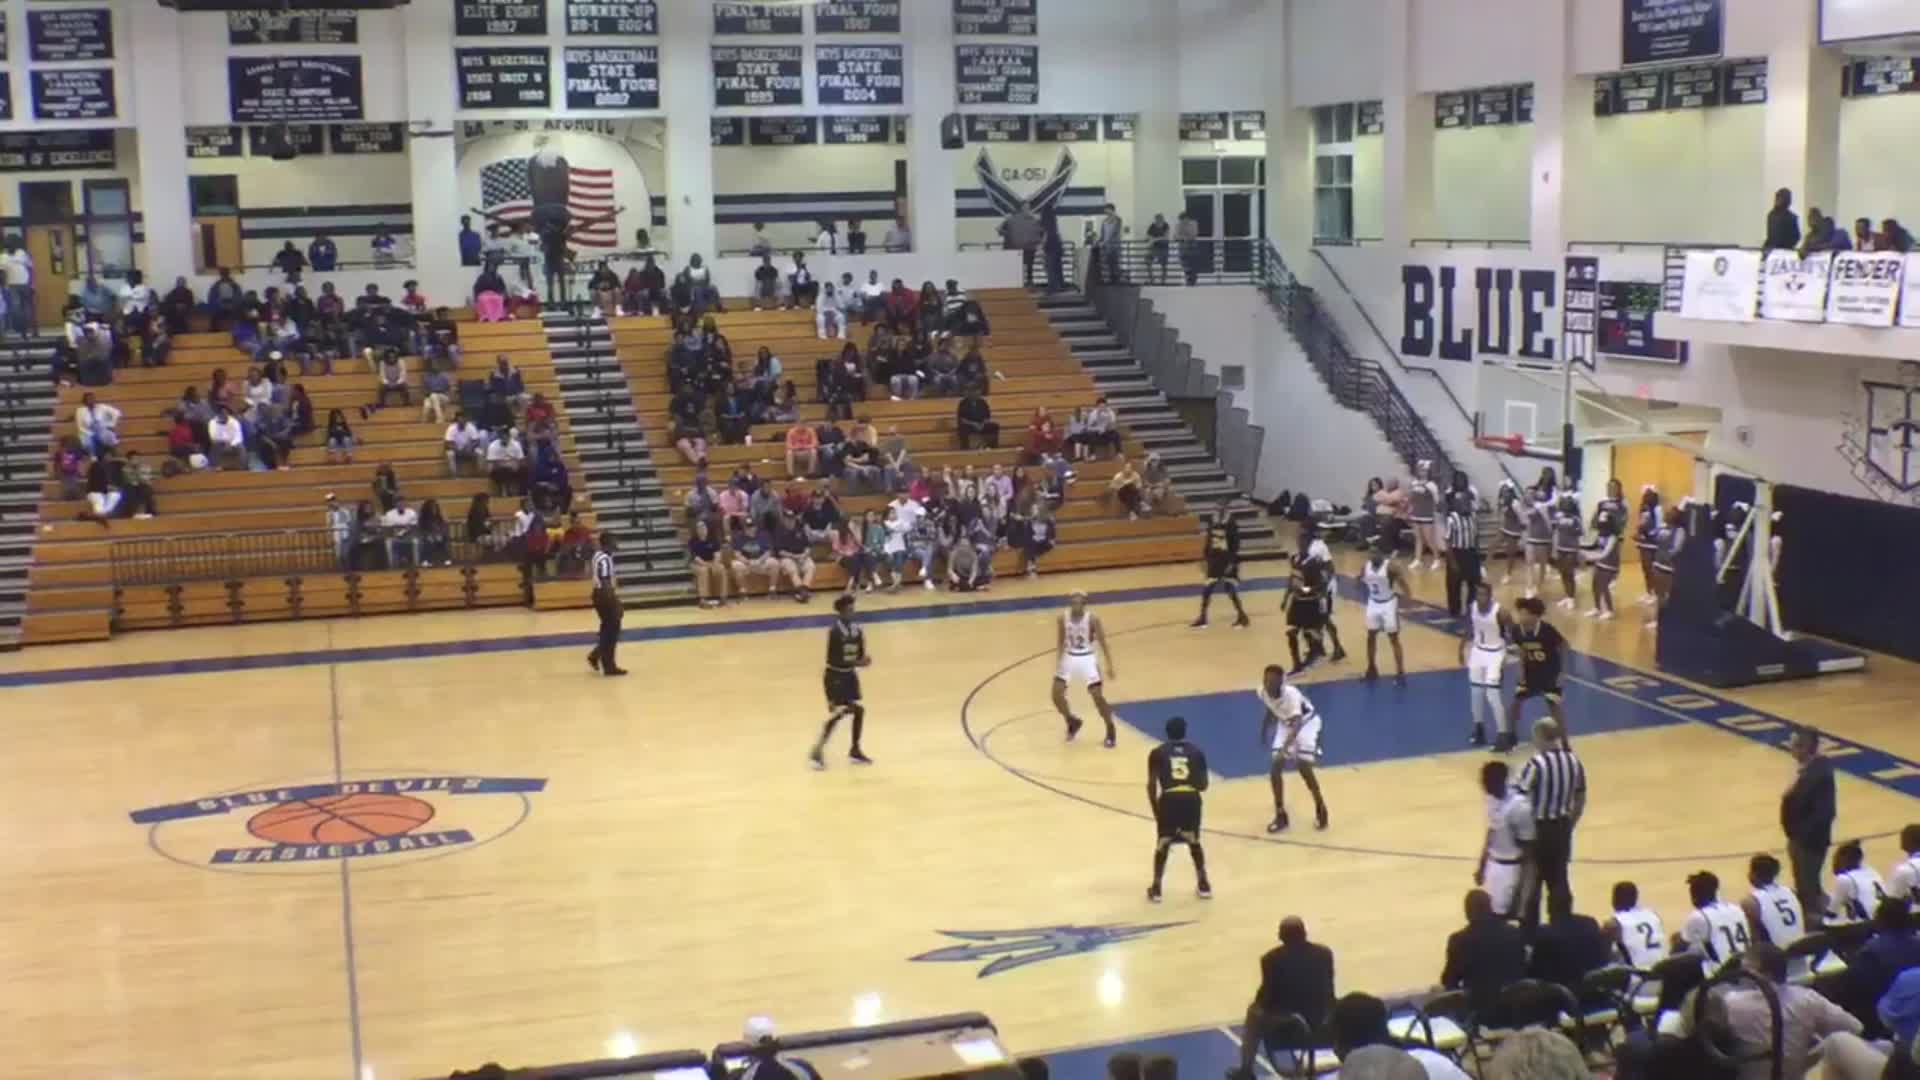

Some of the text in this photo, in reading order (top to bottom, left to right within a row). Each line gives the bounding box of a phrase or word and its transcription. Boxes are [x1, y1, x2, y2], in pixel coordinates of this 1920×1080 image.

[464, 5, 539, 18] ELITE EIGHT
[569, 4, 655, 17] RUNNER-UP
[594, 51, 657, 63] BASKETBALL
[588, 65, 635, 77] STATE
[736, 63, 780, 75] STATE
[837, 62, 882, 74] STATE
[568, 79, 657, 91] FINAL FOUR
[716, 77, 800, 89] FINAL FOUR
[819, 75, 901, 87] FINAL FOUR
[1835, 259, 1900, 280] FENDER
[1401, 265, 1555, 362] BLUE
[1169, 756, 1190, 780] 5
[197, 778, 484, 811] BLUE DEVILS
[232, 833, 457, 862] BASKETBALL
[1773, 899, 1797, 926] 5
[1637, 922, 1661, 948] 2
[1718, 922, 1750, 954] 14
